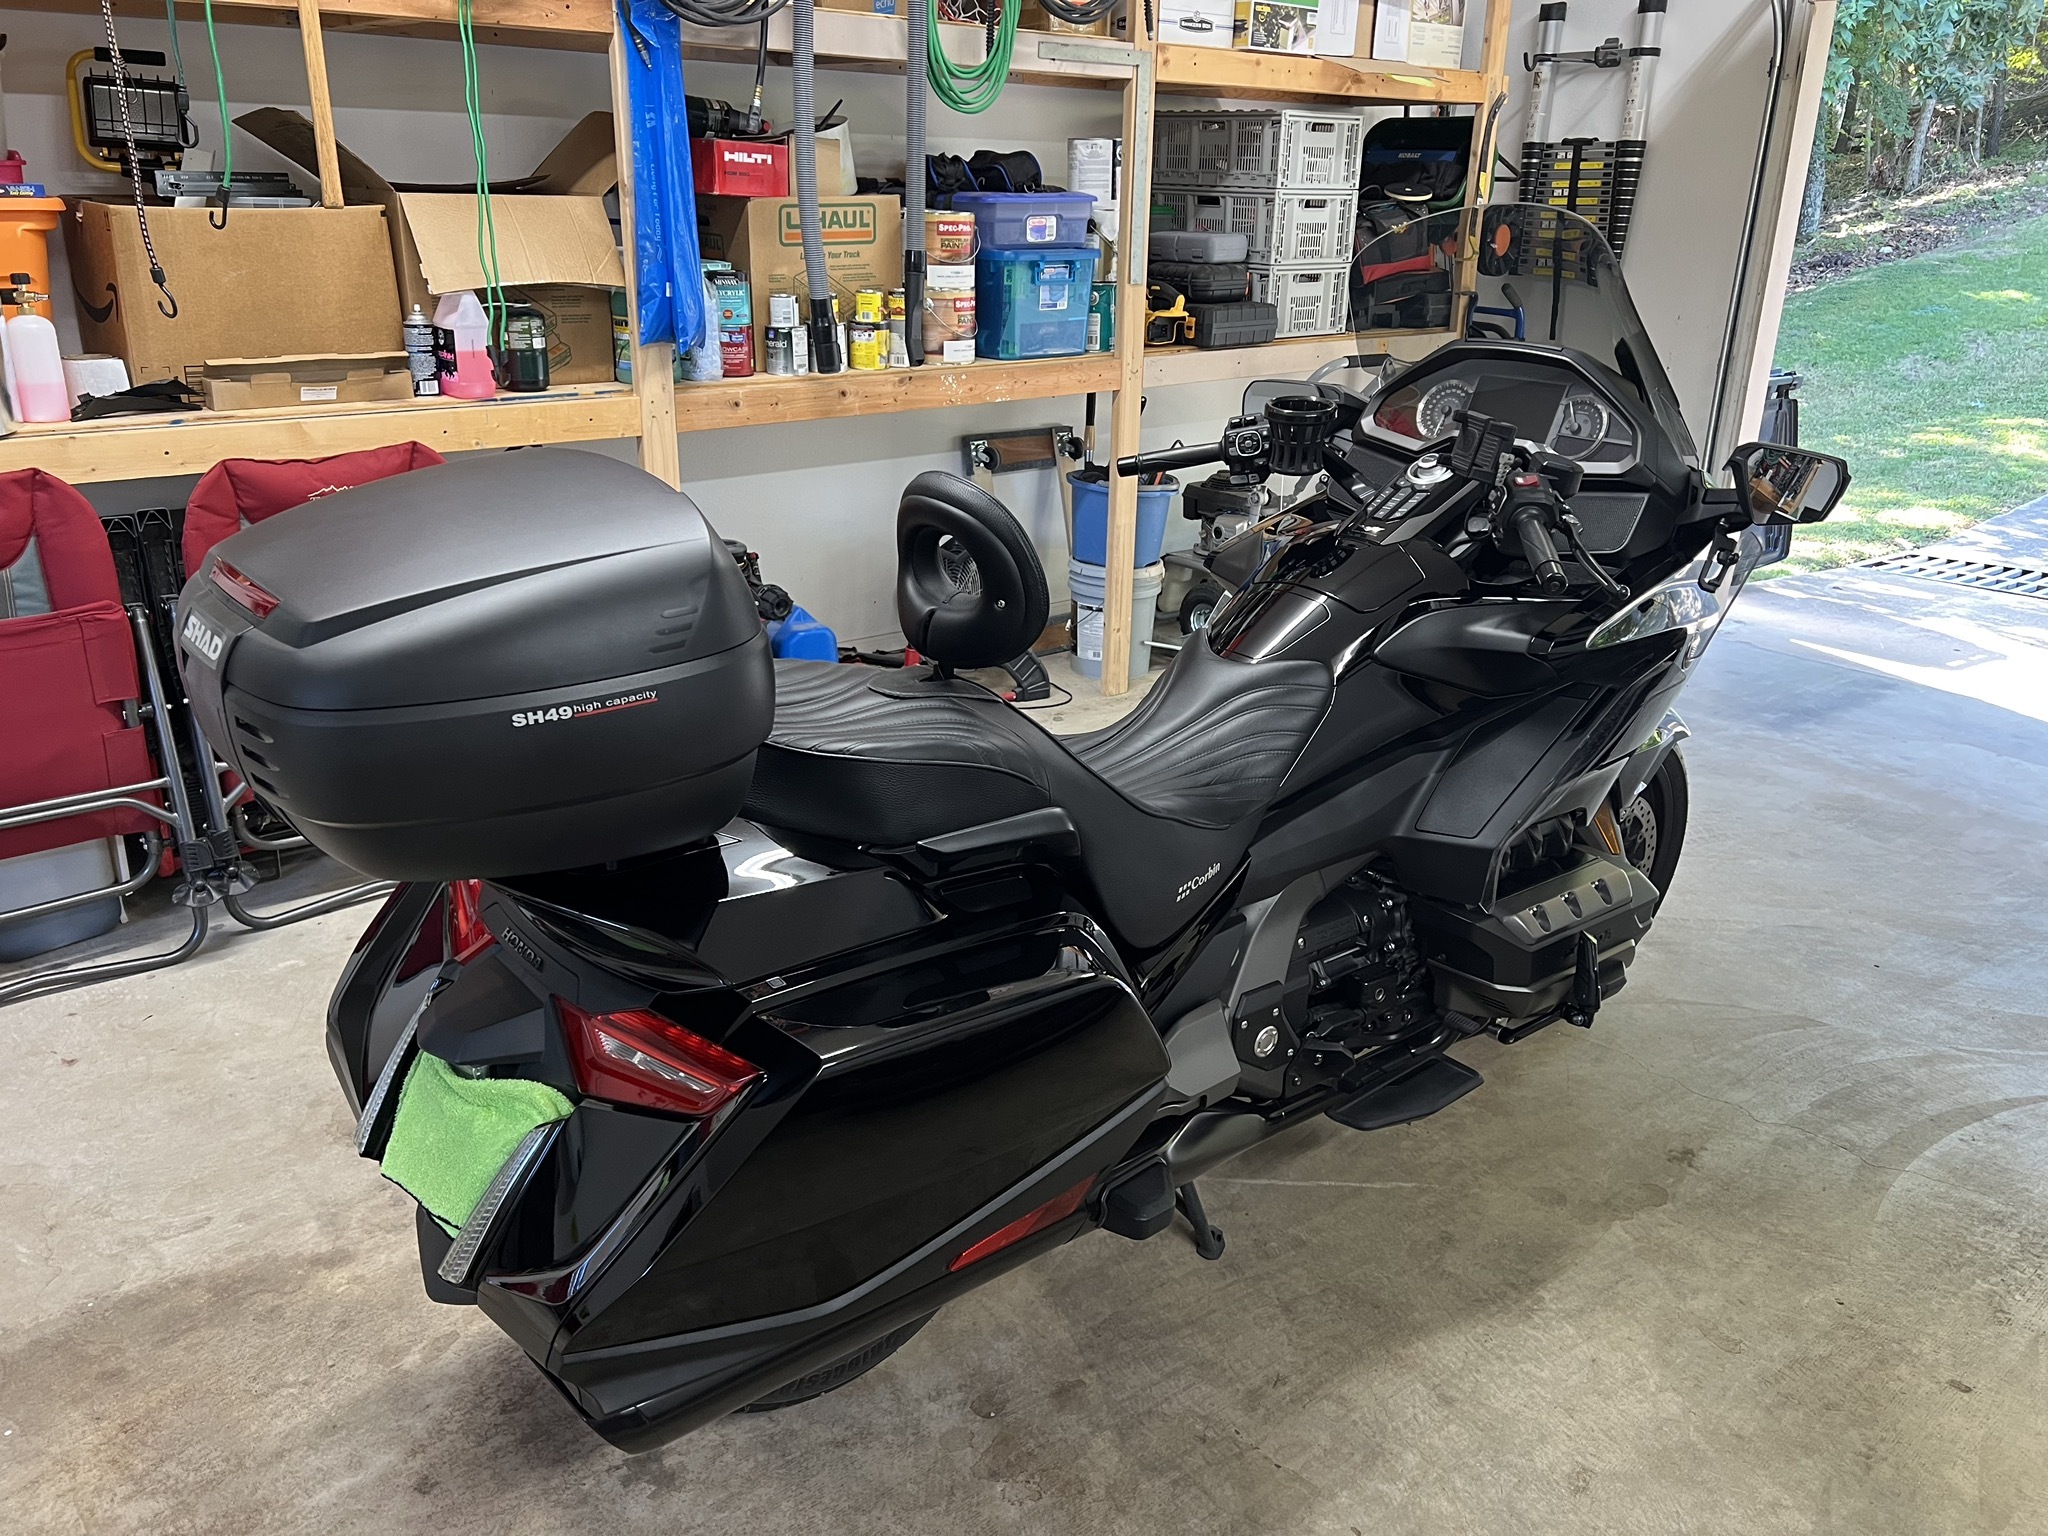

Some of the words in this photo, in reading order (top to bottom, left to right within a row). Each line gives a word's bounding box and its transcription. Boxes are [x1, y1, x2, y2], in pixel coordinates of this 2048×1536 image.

[723, 150, 772, 165] HILTI
[786, 210, 870, 230] UHAUL
[827, 251, 842, 259] Your
[843, 250, 861, 258] Truck
[183, 615, 223, 661] SHAD
[511, 705, 573, 728] SH49
[573, 701, 602, 713] high
[605, 690, 658, 707] capacity
[1191, 862, 1221, 890] Corbin
[501, 926, 543, 971] HONDA
